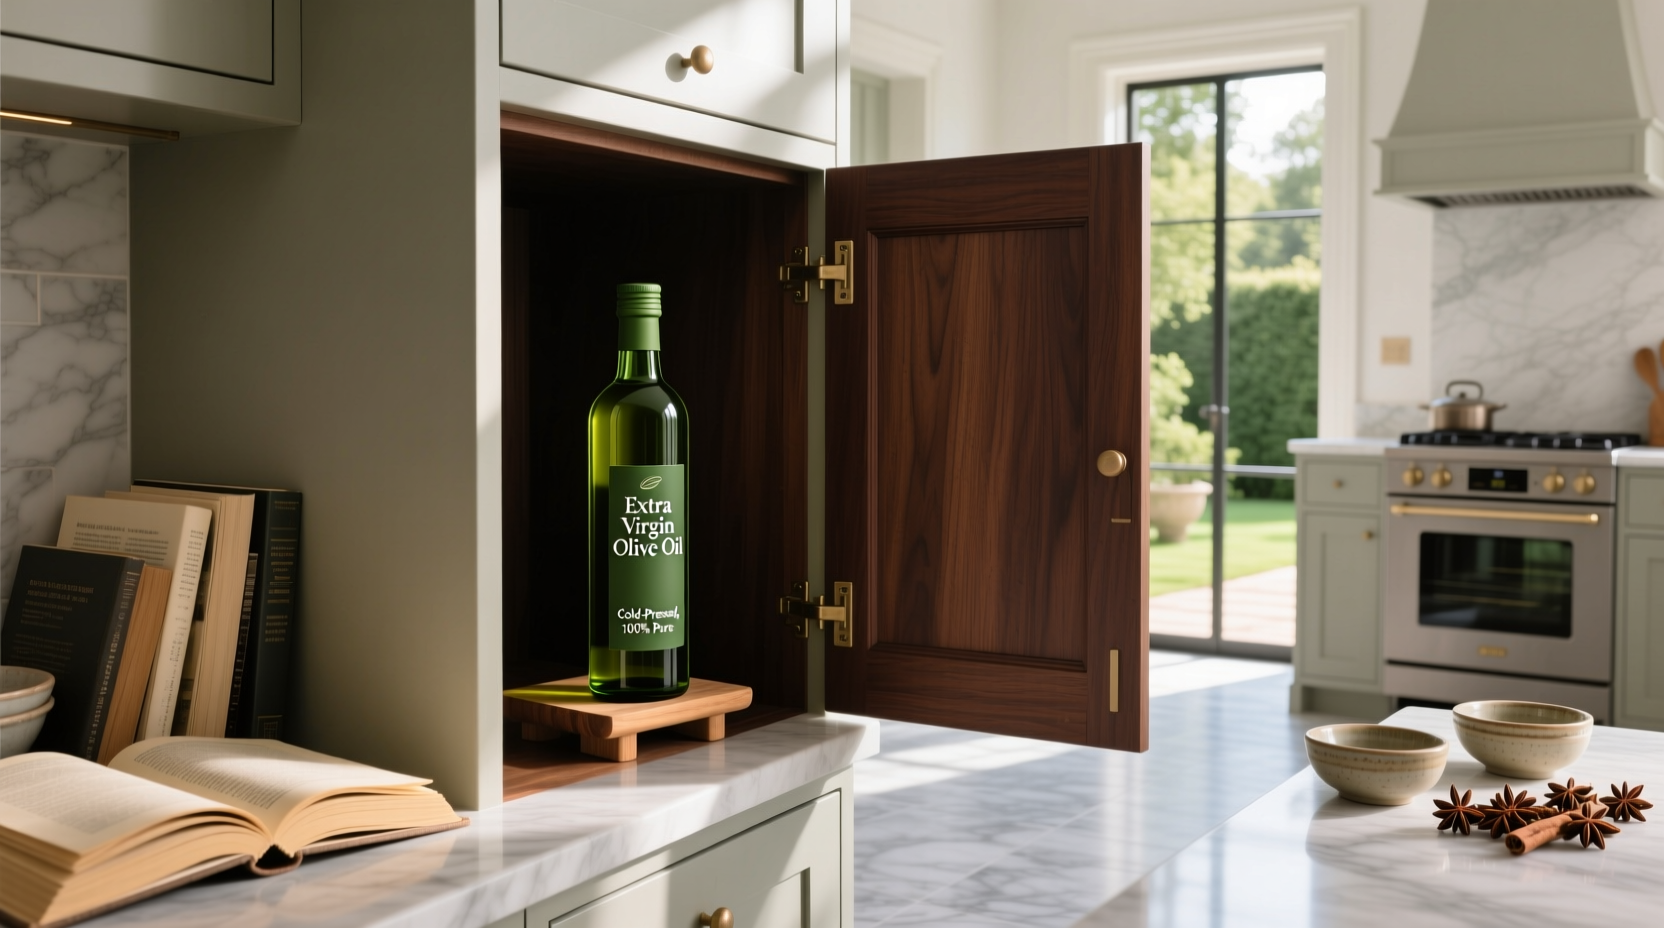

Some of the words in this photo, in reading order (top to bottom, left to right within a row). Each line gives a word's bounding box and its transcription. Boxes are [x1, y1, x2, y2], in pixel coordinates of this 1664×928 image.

[624, 496, 672, 514] Extra
[621, 516, 675, 539] Virgin
[613, 537, 659, 556] Olive
[661, 536, 684, 555] Oil
[622, 622, 651, 634] 100%
